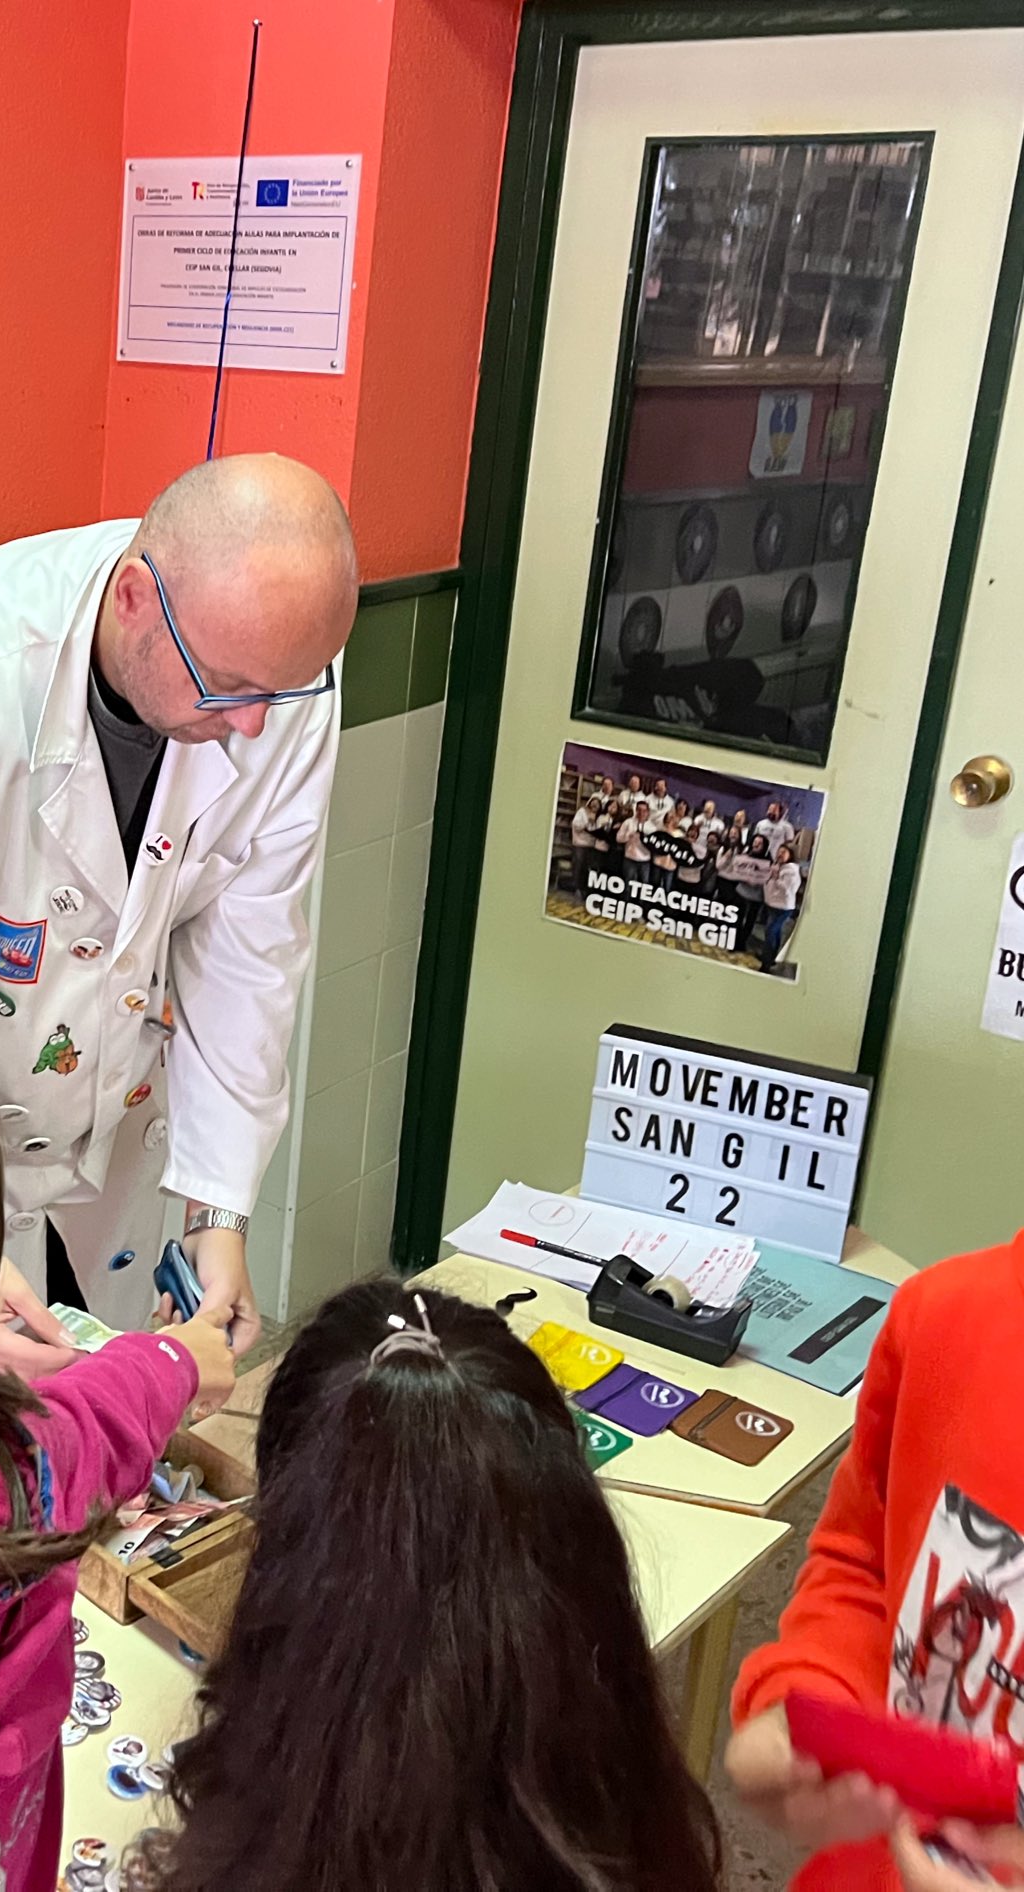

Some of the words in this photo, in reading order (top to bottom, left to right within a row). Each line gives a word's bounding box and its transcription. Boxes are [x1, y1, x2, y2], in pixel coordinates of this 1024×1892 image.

[137, 229, 156, 237] OBRAS
[244, 230, 263, 238] AULAS
[331, 231, 340, 239] DE
[260, 248, 286, 256] INFANTIL
[585, 893, 643, 924] CEIP
[646, 908, 693, 940] San
[698, 923, 737, 950] Gil
[587, 870, 625, 894] MO
[628, 880, 739, 923] TEACHERS
[611, 1050, 849, 1136] MOVEMBER
[612, 1107, 695, 1157] SAN
